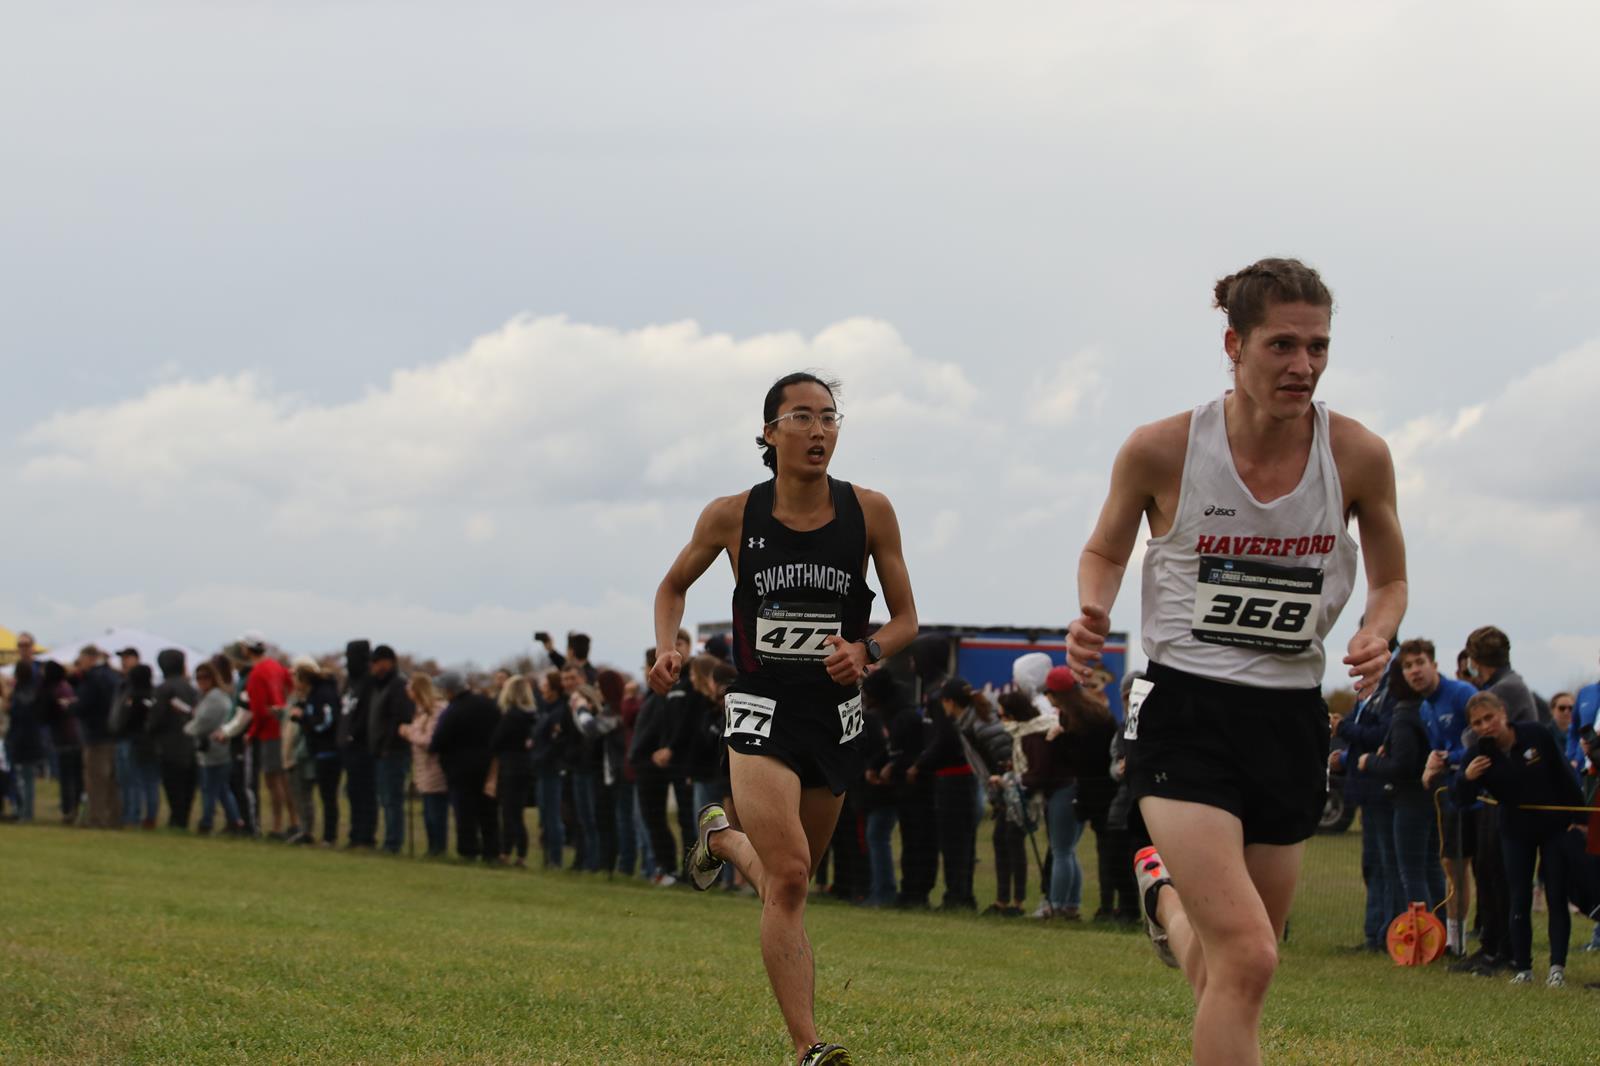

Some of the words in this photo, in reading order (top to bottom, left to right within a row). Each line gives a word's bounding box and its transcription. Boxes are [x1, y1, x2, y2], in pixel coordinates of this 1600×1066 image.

[1214, 507, 1237, 517] asics
[1195, 534, 1336, 556] HAVERFORD
[754, 563, 852, 596] SWARTHMORE
[1241, 574, 1267, 584] COUNTRY
[1267, 577, 1313, 589] CHAMPIONSHIPS
[1202, 594, 1312, 632] 368
[760, 626, 839, 651] 477
